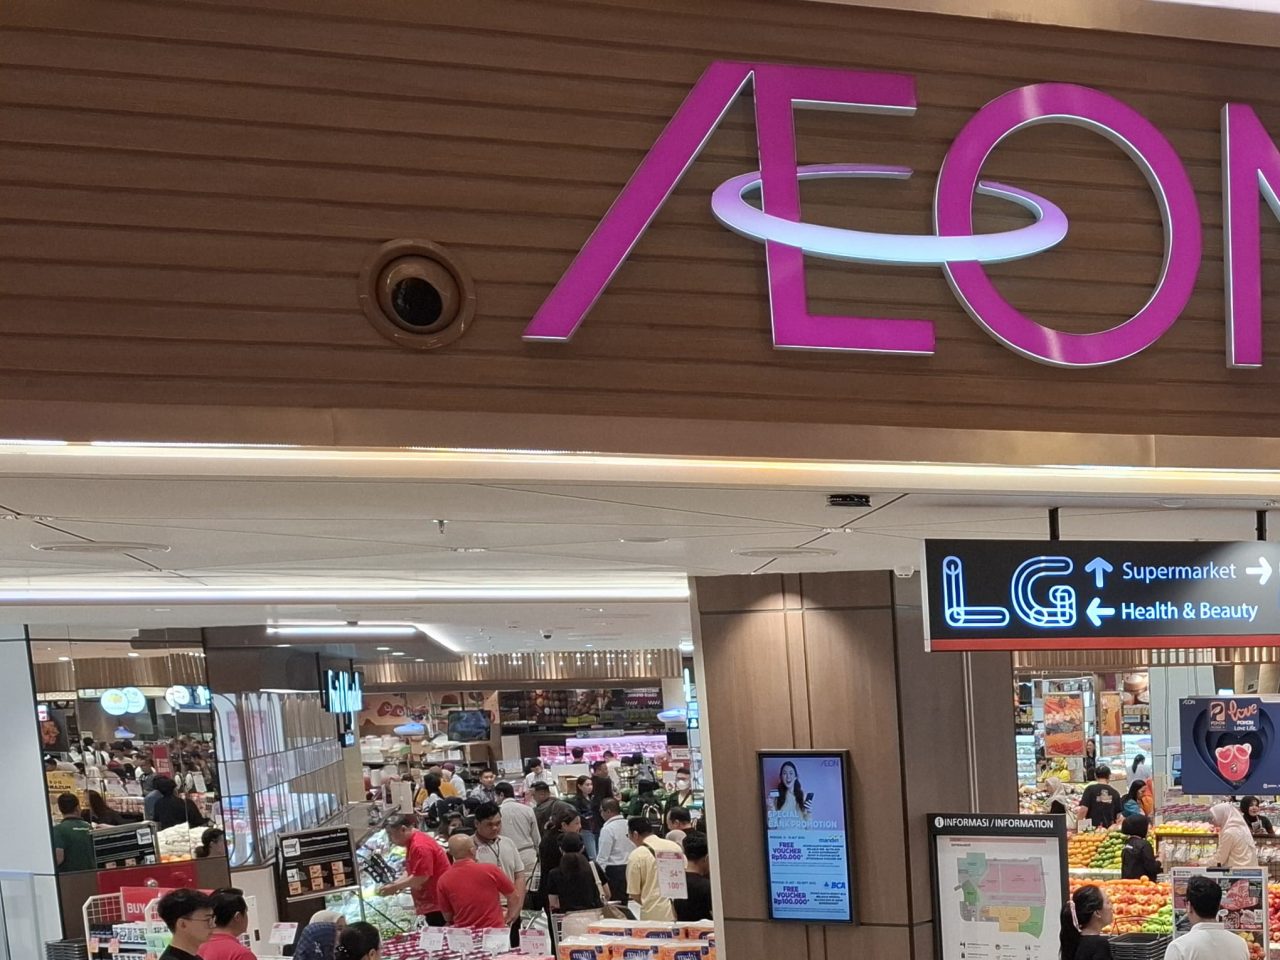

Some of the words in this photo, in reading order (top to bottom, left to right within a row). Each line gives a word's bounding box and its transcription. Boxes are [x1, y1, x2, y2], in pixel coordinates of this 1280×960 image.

[942, 556, 1077, 627] LG
[1122, 562, 1237, 583] Supermarket
[1121, 603, 1178, 620] Health
[1182, 602, 1198, 620] &
[1200, 602, 1259, 623] Beauty
[790, 820, 838, 829] PROMOTION
[944, 818, 989, 827] INFORMASI
[995, 819, 1054, 829] INFORMATION
[831, 882, 846, 890] BCA
[127, 903, 145, 913] BUY
[572, 950, 592, 960] multi
[626, 951, 648, 960] multi
